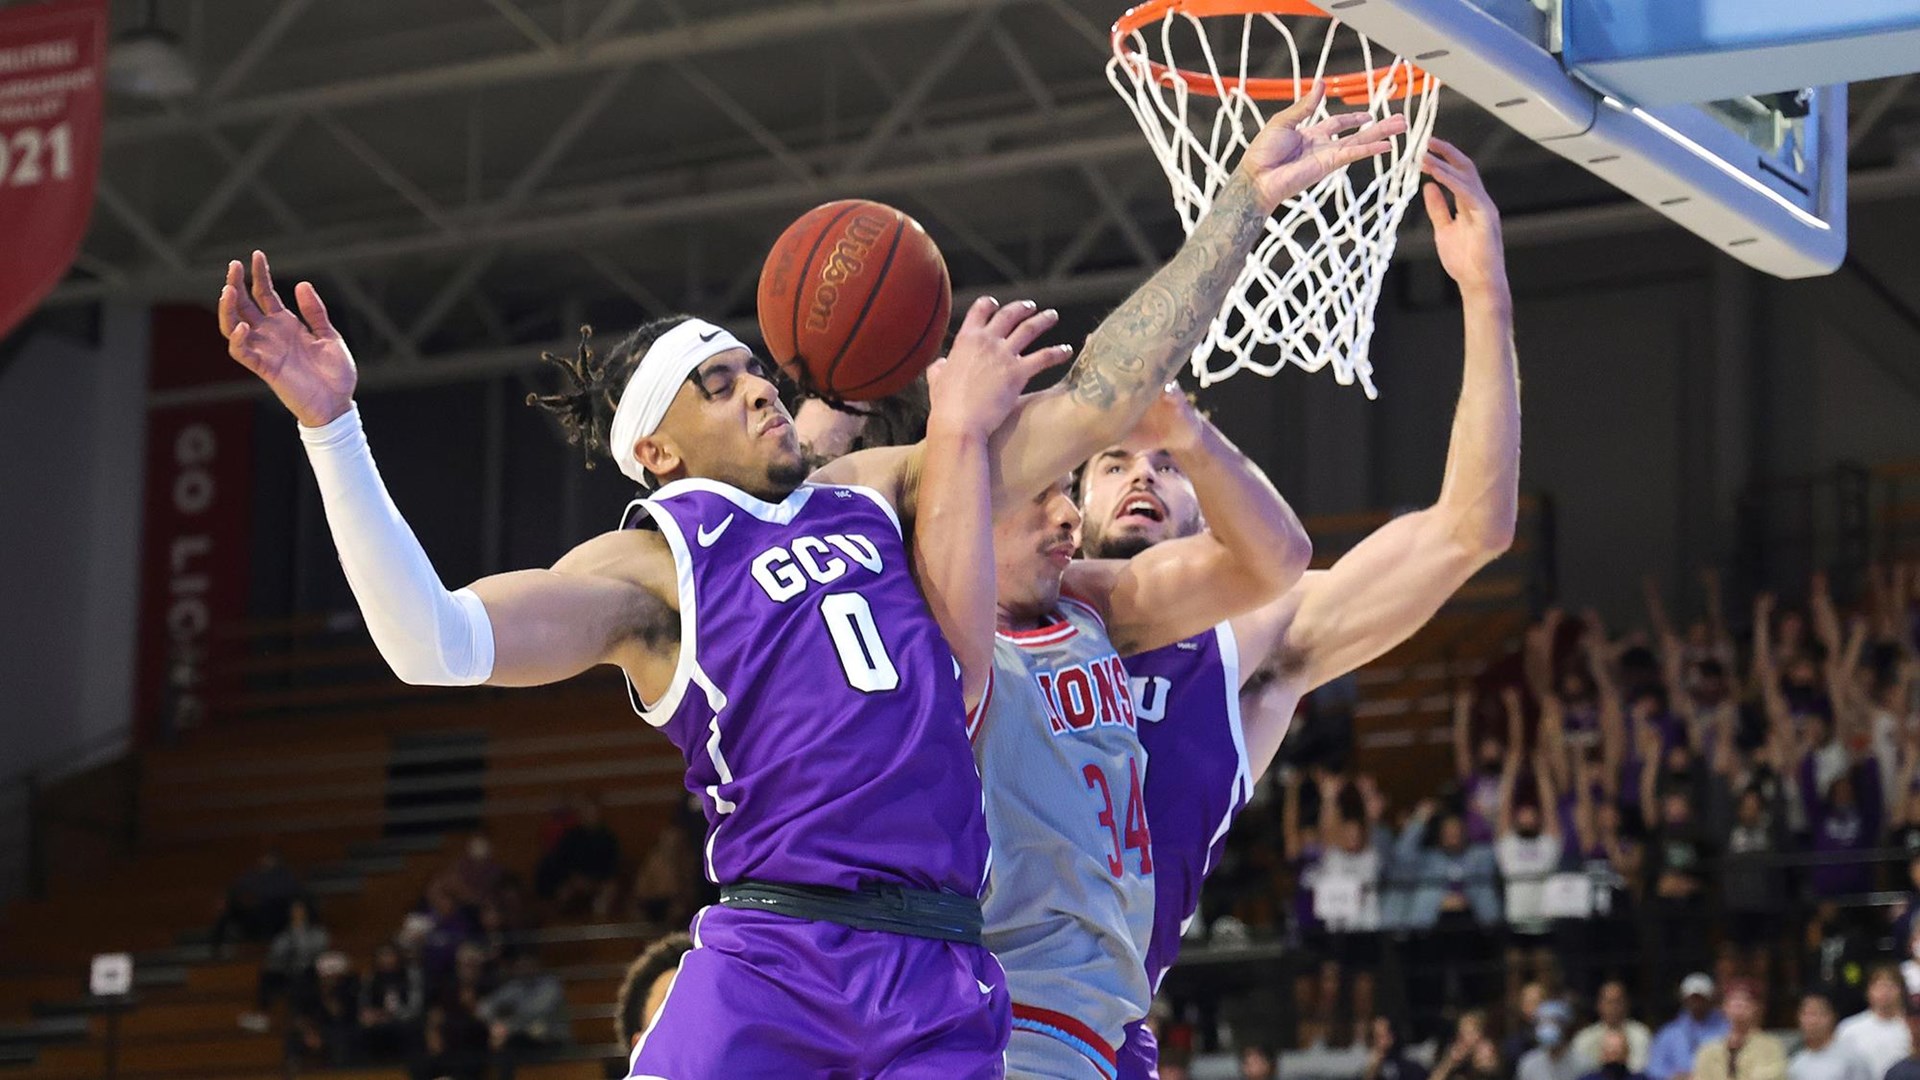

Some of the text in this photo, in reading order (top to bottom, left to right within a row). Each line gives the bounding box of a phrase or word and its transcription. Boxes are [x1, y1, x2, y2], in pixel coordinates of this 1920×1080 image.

[806, 214, 887, 334] Wilson
[750, 534, 884, 603] GCU
[818, 591, 900, 693] 0
[1035, 654, 1137, 736] IONS
[1081, 756, 1153, 879] 34
